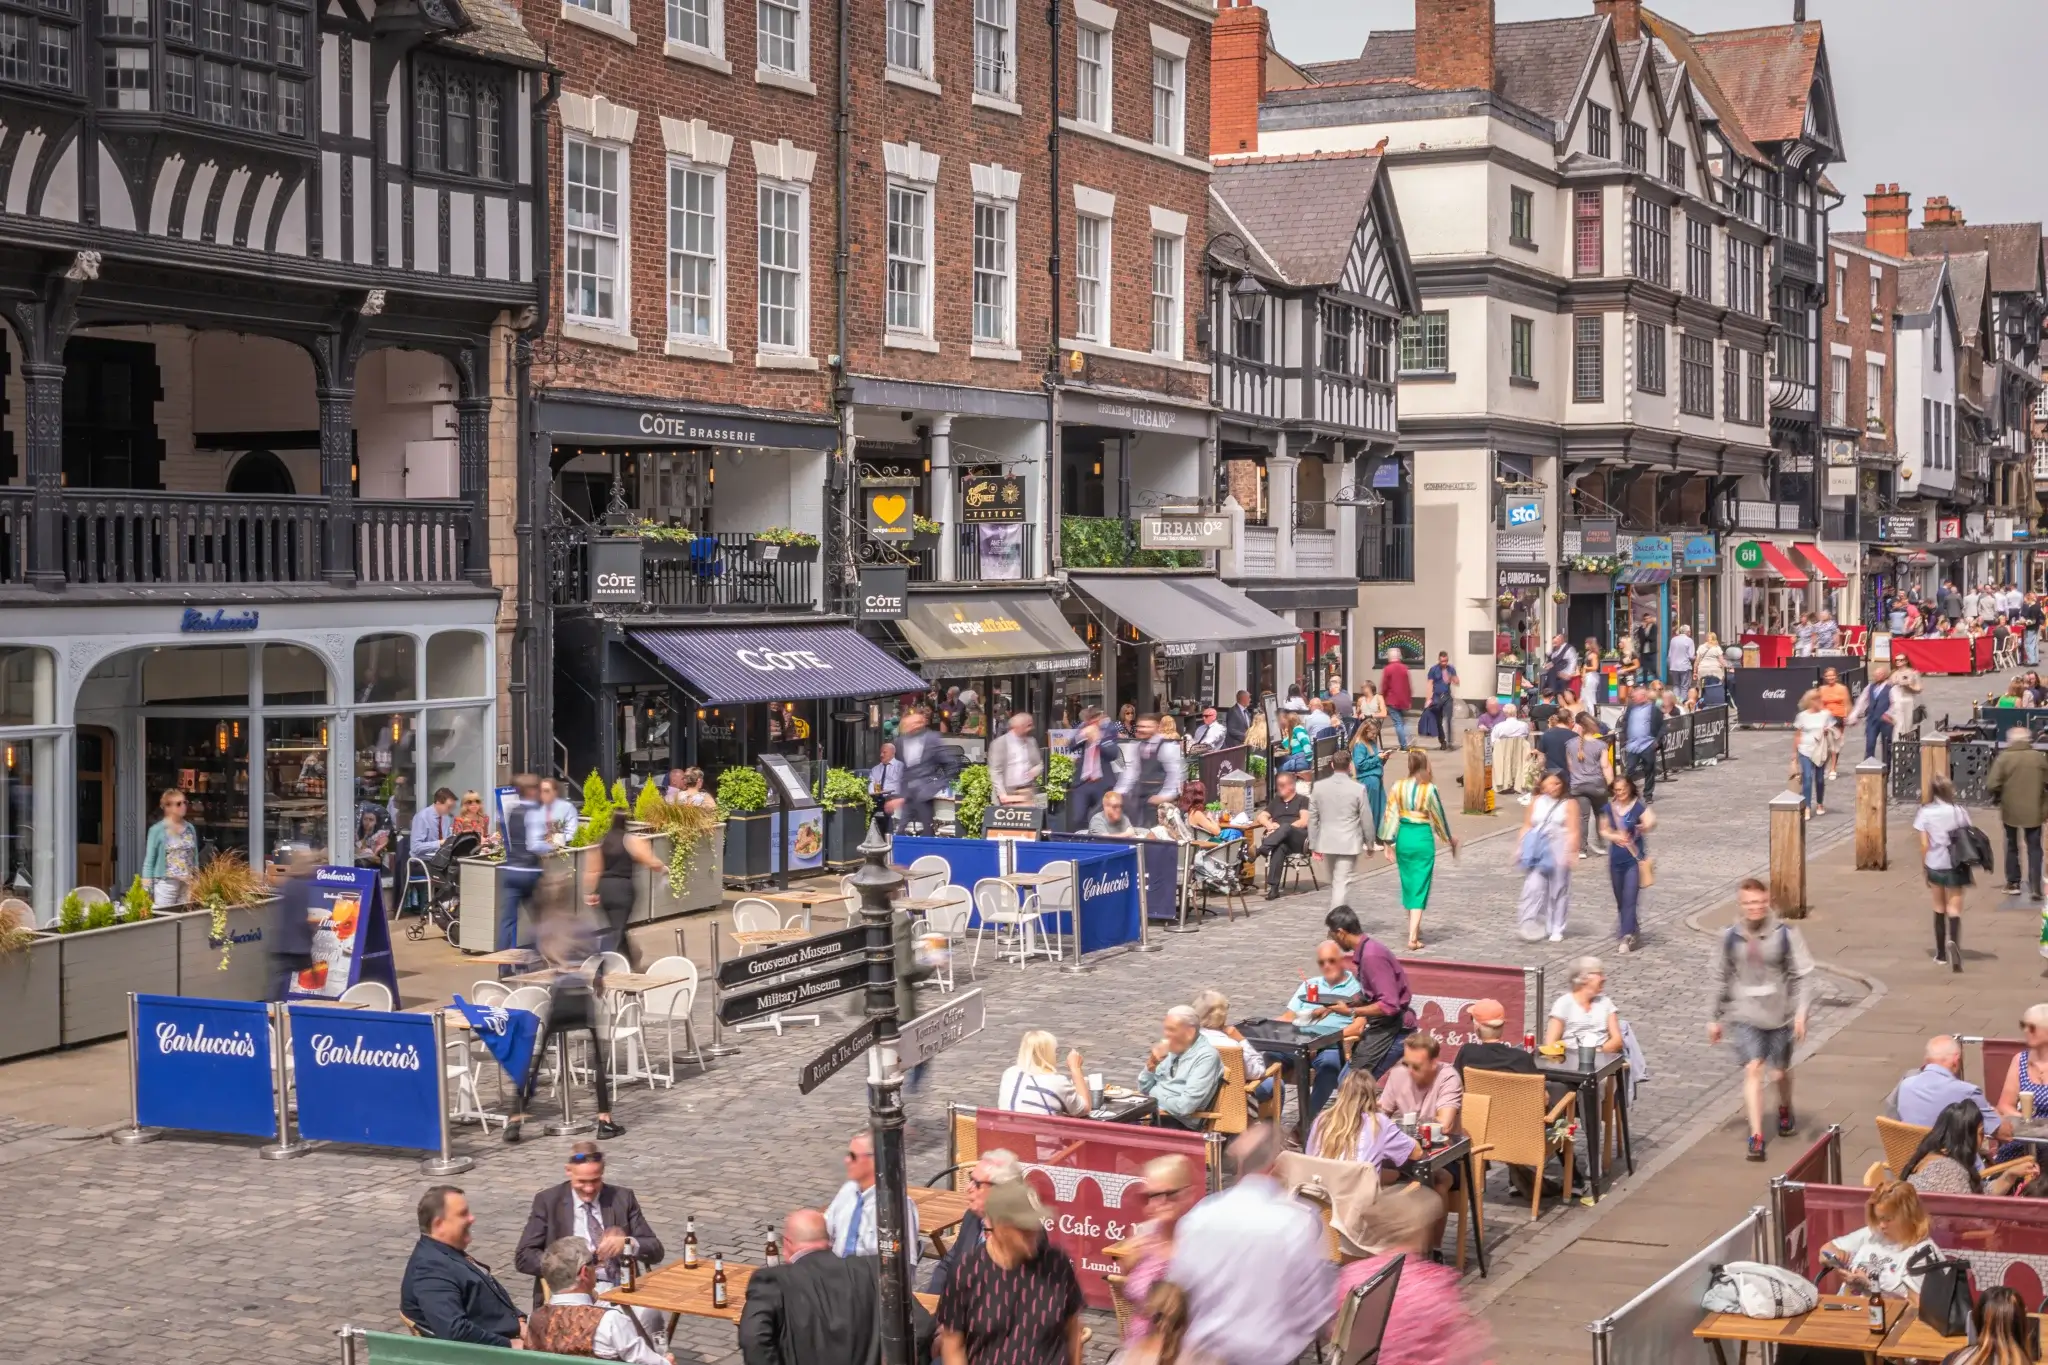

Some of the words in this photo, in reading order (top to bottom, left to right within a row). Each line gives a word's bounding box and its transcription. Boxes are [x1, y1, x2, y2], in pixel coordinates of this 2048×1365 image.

[639, 412, 685, 437] CÔTE
[690, 427, 756, 442] BRASSERIE
[973, 510, 1014, 518] TATTOO
[597, 572, 636, 588] CÔTE
[1507, 572, 1531, 585] RAINBOW
[865, 594, 902, 607] CÔTE
[736, 646, 833, 671] CÔTE
[994, 808, 1032, 821] CÔTE
[316, 868, 356, 882] Carluccio's
[1082, 870, 1130, 901] Carluccio's
[748, 951, 798, 975] Grosvenor
[799, 942, 841, 962] Museum
[757, 989, 798, 1010] Military
[799, 979, 841, 996] Museum
[156, 1022, 255, 1058] Carluccio's
[1447, 1031, 1464, 1046] &
[311, 1033, 420, 1071] Carluccio's
[812, 1058, 831, 1083] River
[832, 1052, 839, 1067] &
[838, 1044, 851, 1063] The
[852, 1030, 874, 1053] Groves
[1059, 1214, 1100, 1238] Cafe
[1105, 1220, 1125, 1240] &
[1081, 1257, 1121, 1274] Lunch
